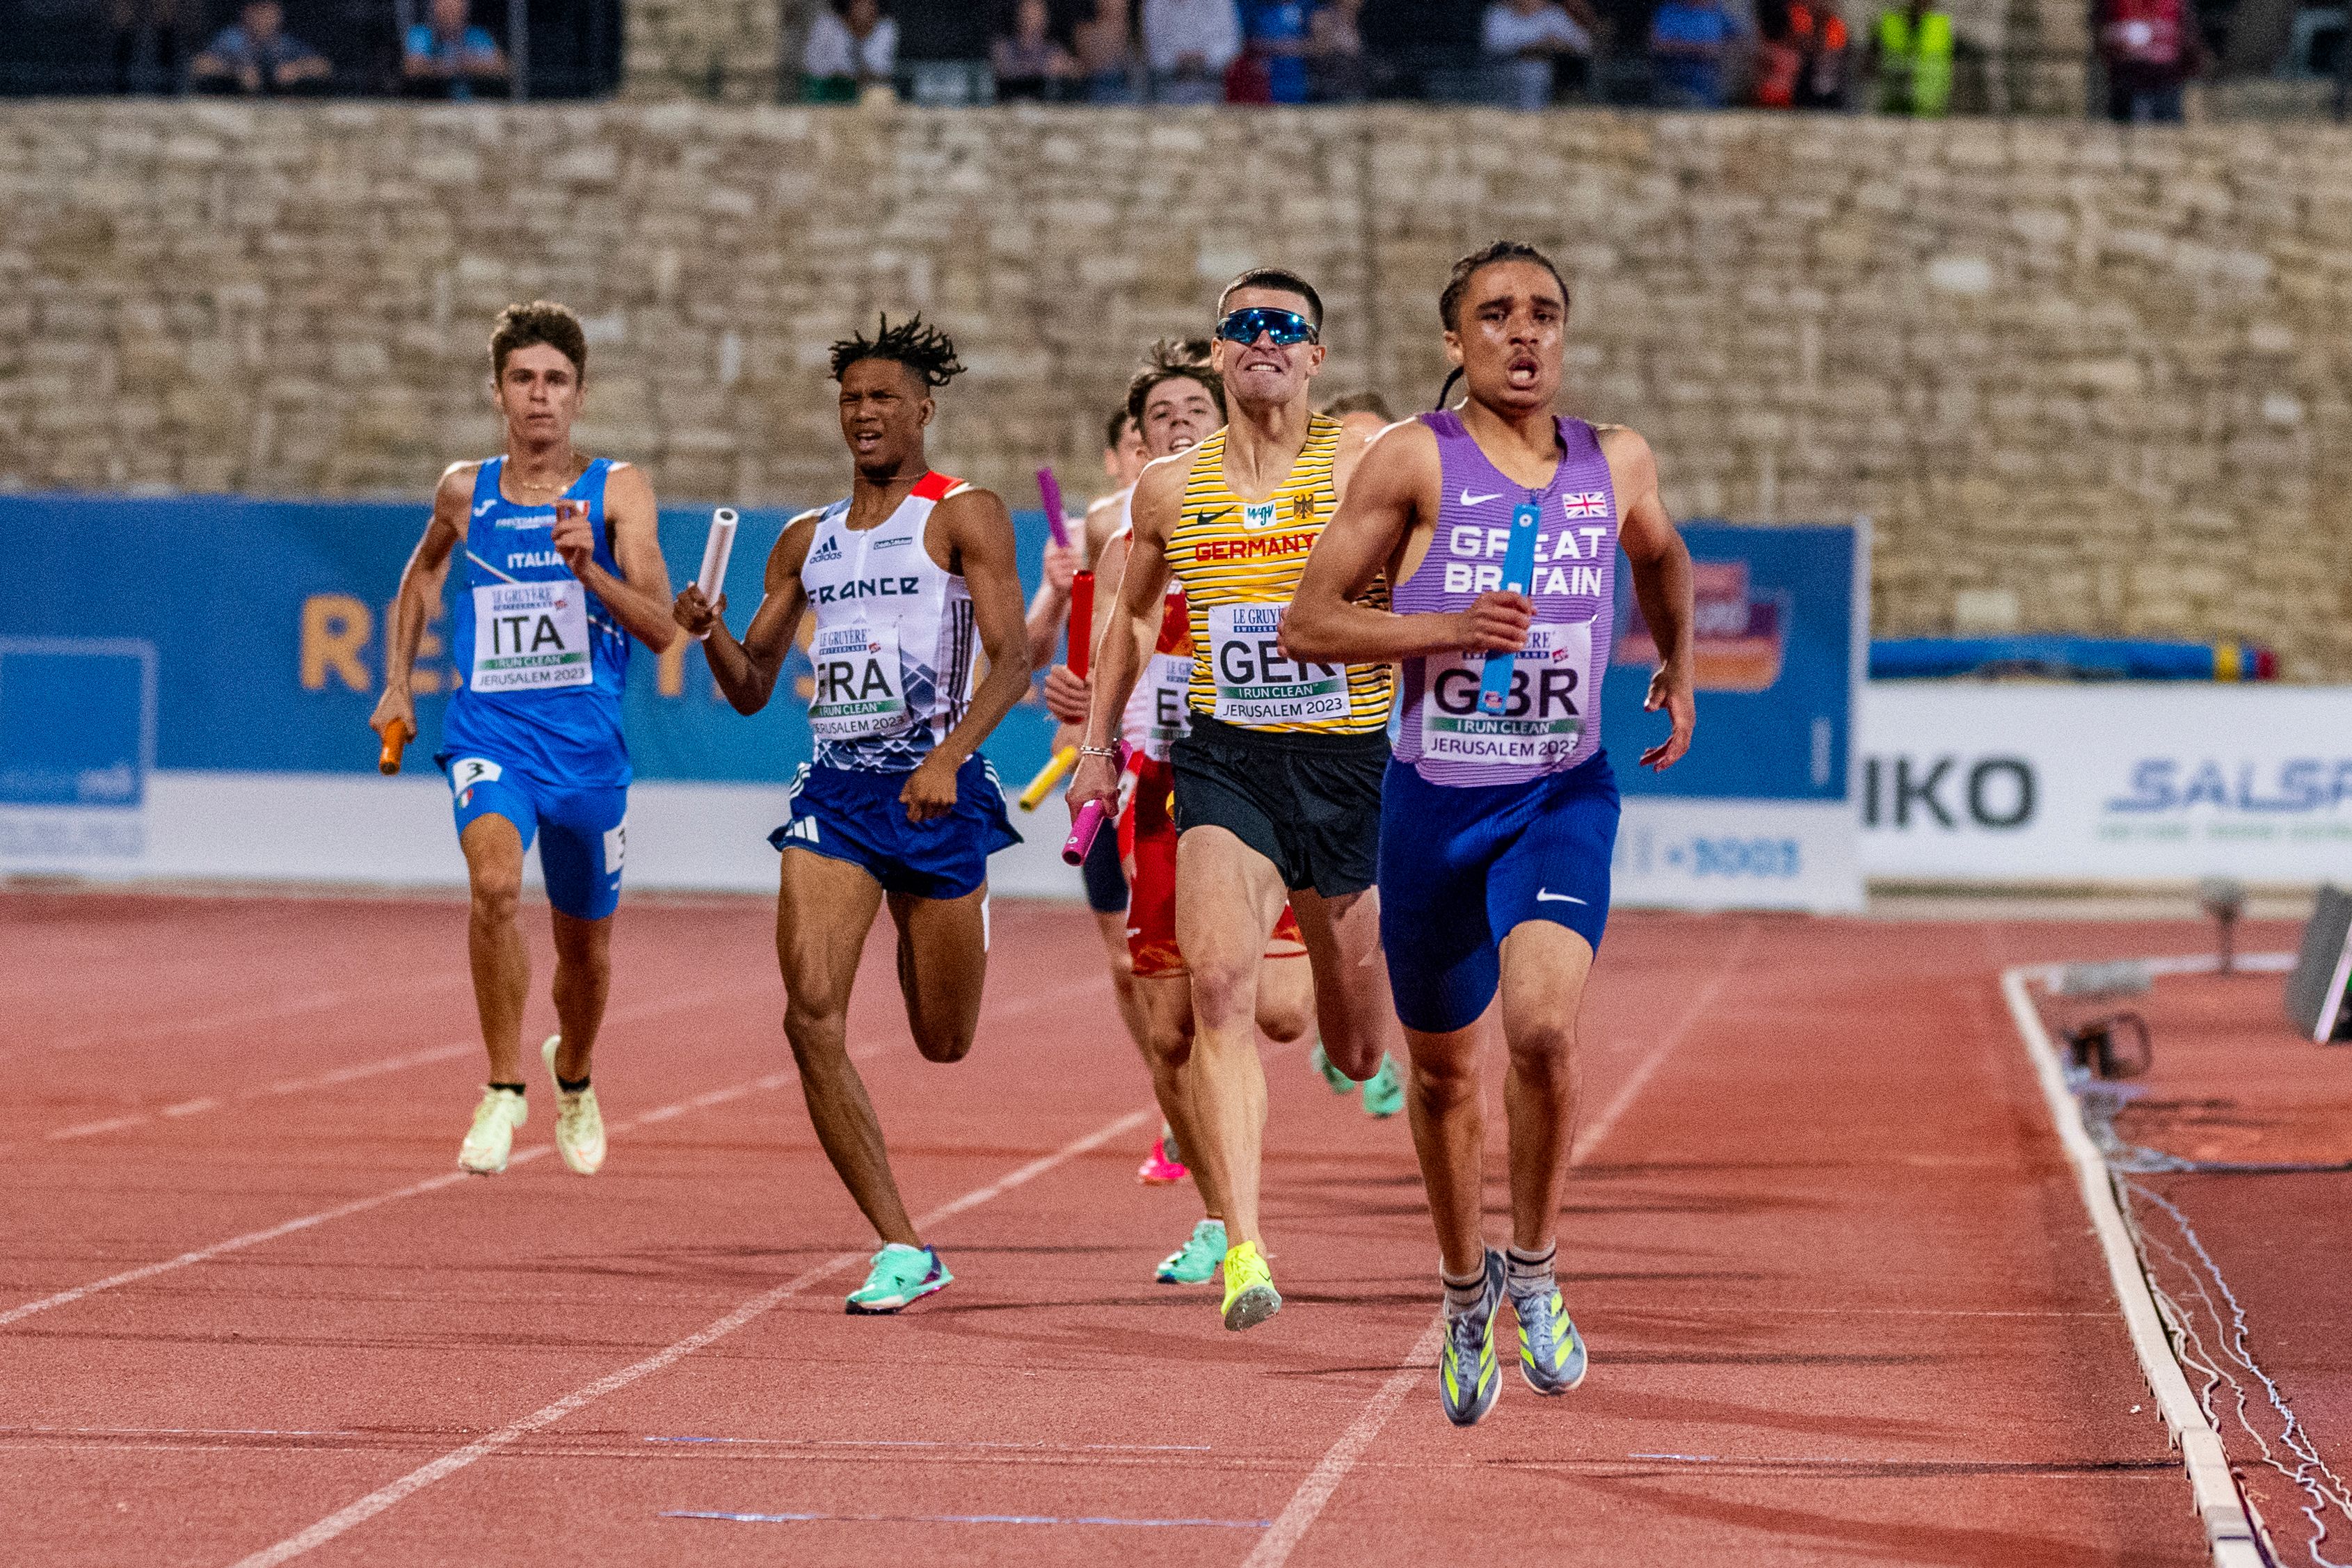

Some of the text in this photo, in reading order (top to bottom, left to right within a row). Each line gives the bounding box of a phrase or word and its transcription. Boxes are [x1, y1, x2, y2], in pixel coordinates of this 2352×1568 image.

[1194, 531, 1318, 562] GERMANY
[507, 550, 565, 569] ITALIA
[809, 551, 842, 564] adidas
[1444, 563, 1603, 598] BRTAIN
[807, 577, 920, 607] FRANCE
[1233, 609, 1246, 624] LE
[493, 614, 565, 655] ITA
[479, 667, 585, 686] JERUSALEM 2023
[817, 658, 894, 703] FRA
[1244, 687, 1270, 698] RUN
[1434, 668, 1580, 718] GBR
[824, 705, 842, 717] RUN
[1223, 697, 1343, 718] JERUSALEM 2023
[813, 720, 870, 735] ERUSALEM
[1464, 721, 1498, 734] RUN
[1431, 737, 1535, 757] JERUSALEM
